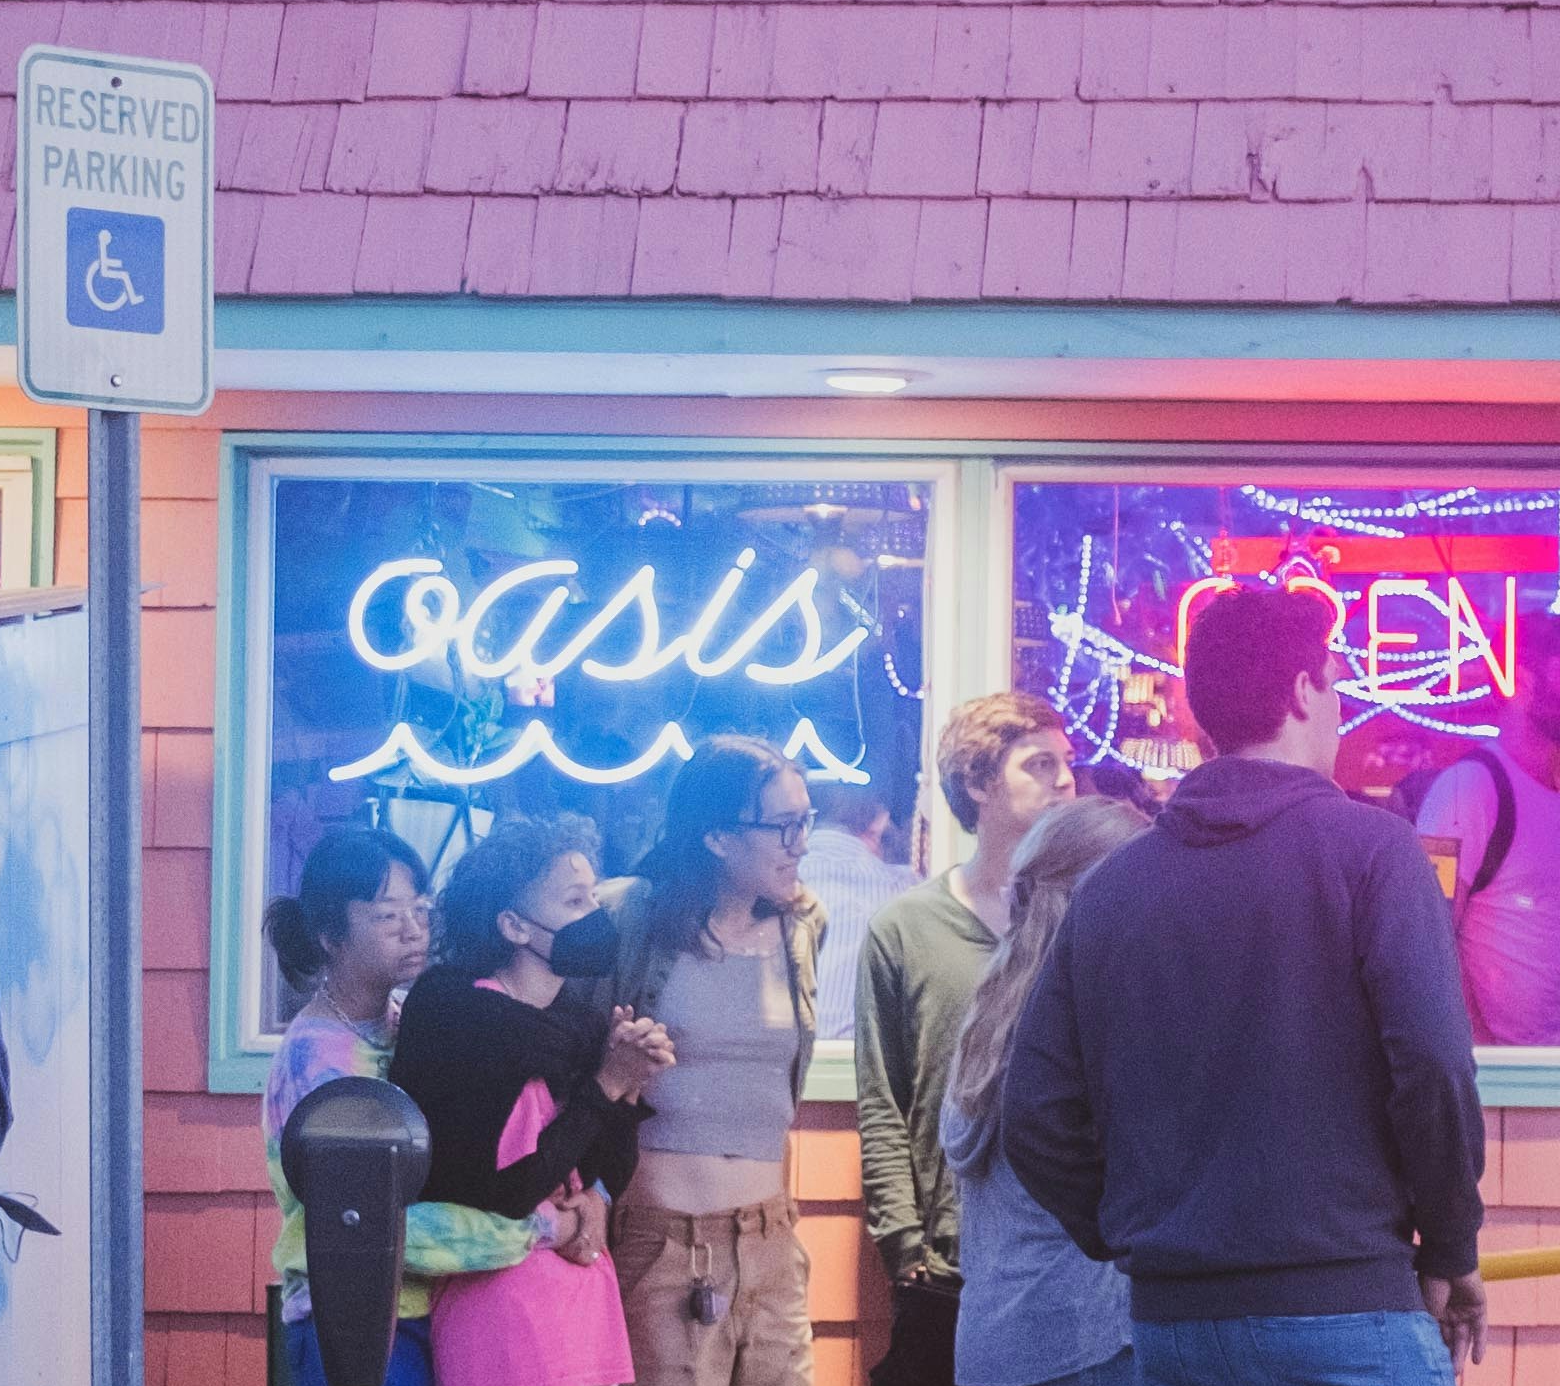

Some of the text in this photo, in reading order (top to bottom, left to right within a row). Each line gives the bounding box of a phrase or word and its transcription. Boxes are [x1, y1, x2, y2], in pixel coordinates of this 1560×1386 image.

[37, 83, 200, 144] RESERVED
[43, 145, 185, 201] PARKING
[348, 547, 870, 685] oasis
